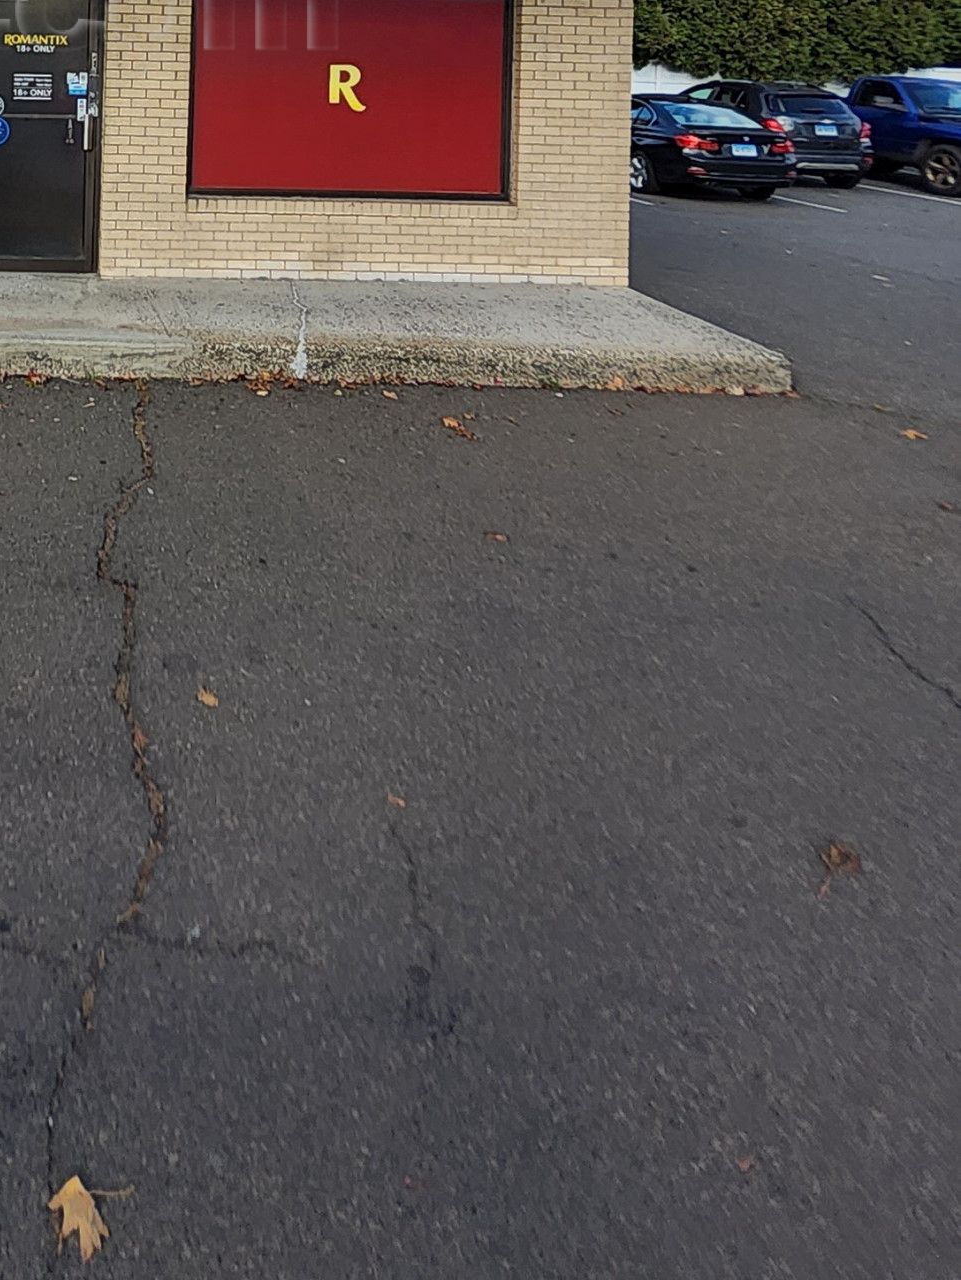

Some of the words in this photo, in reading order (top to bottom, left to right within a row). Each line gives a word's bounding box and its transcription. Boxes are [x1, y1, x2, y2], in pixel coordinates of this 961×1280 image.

[4, 34, 68, 46] ROMANTIX
[33, 45, 55, 53] ONLY
[30, 89, 52, 97] ONLY
[329, 64, 367, 112] R
